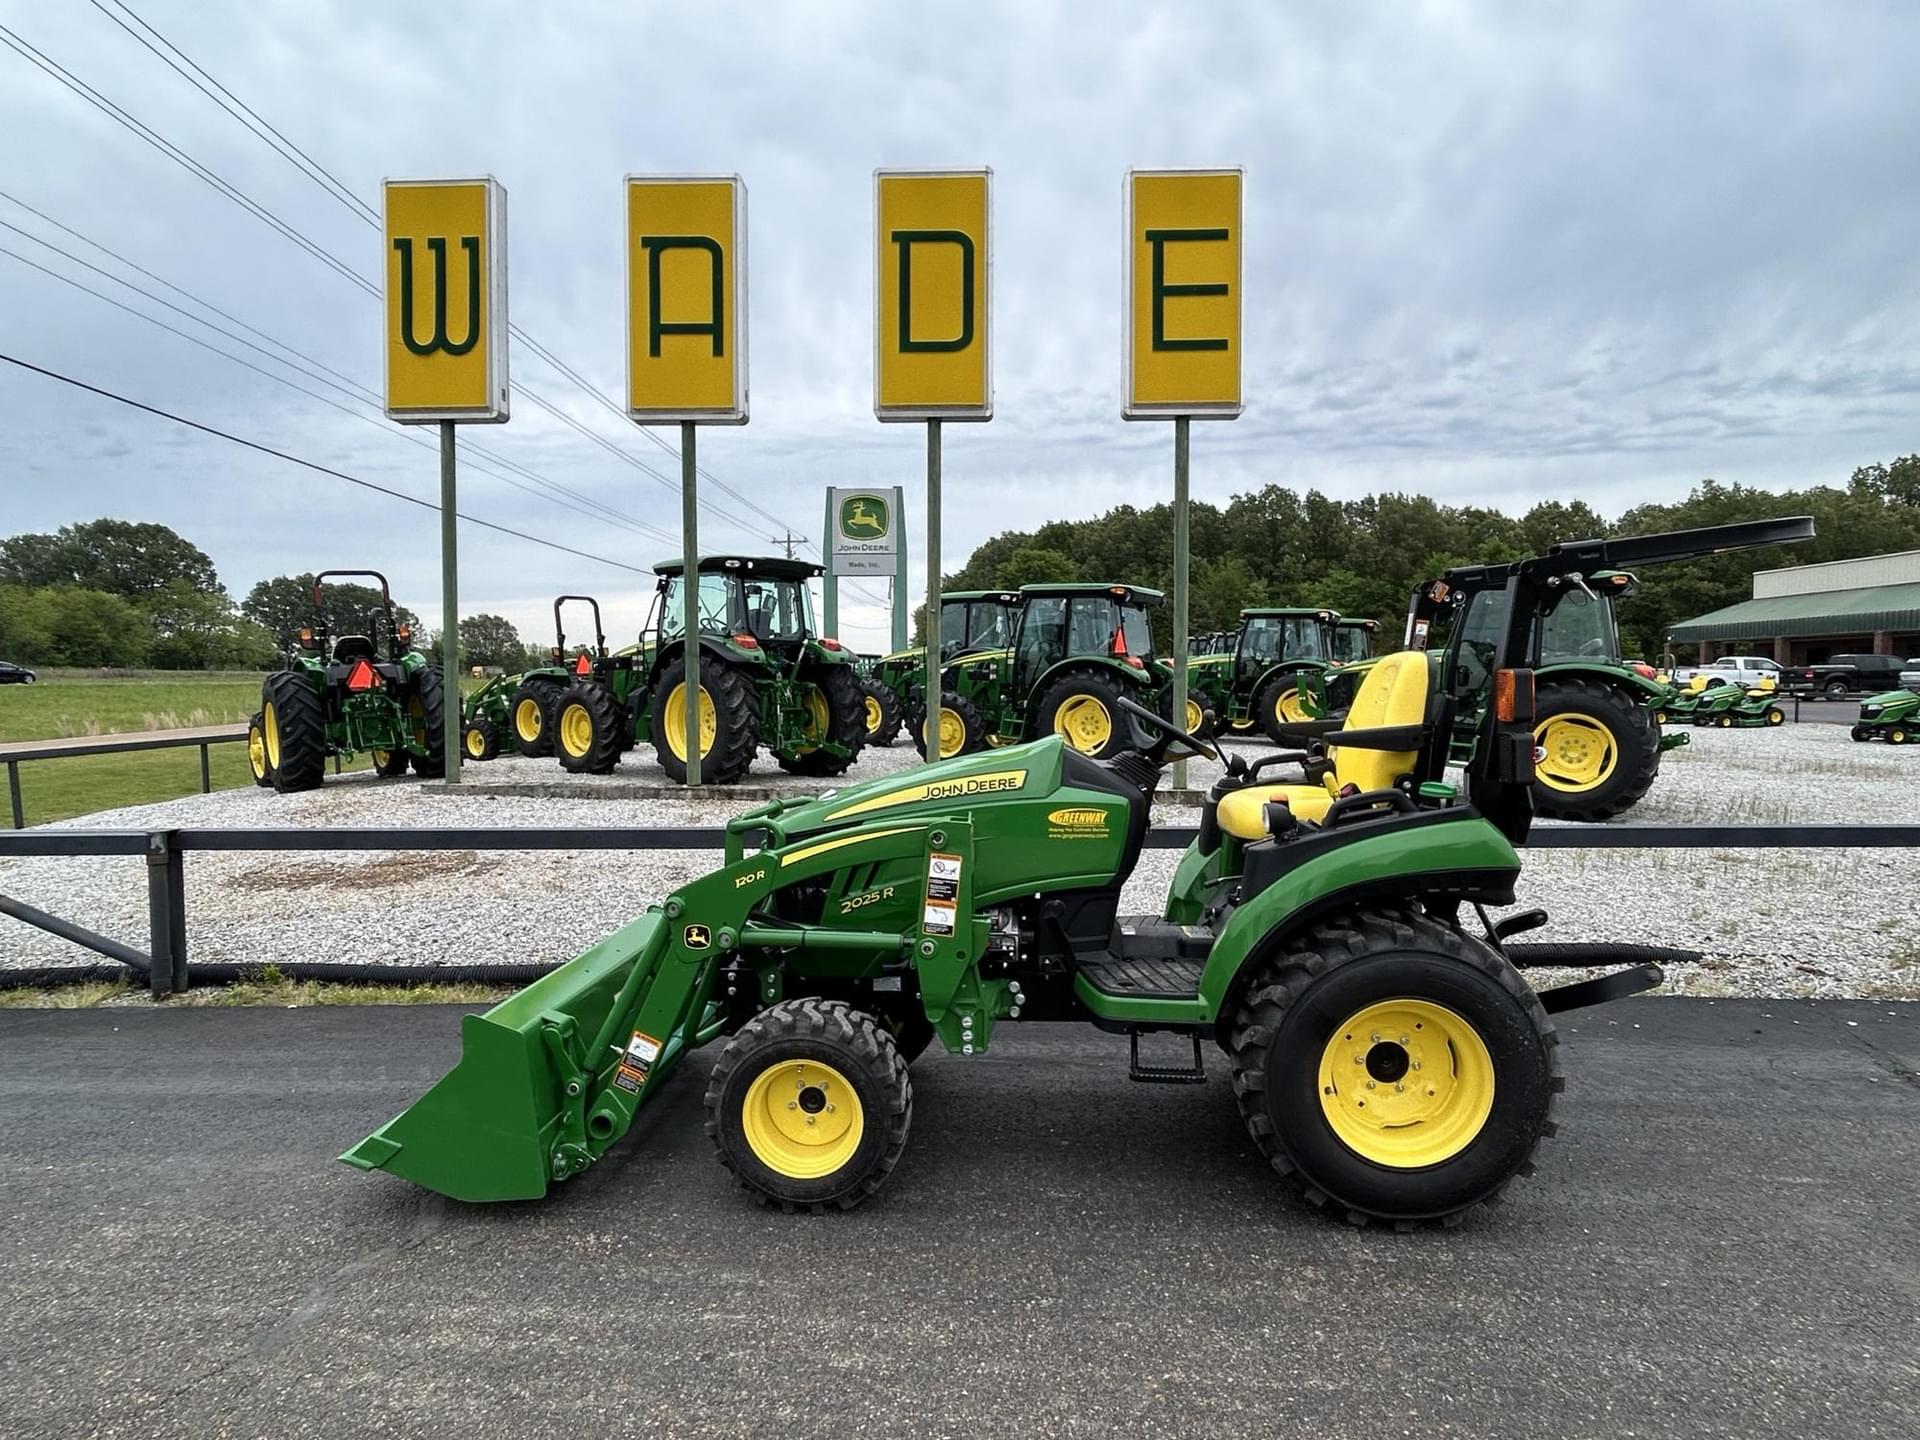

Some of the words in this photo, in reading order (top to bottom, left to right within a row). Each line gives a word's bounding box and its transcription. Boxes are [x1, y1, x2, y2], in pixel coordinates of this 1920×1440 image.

[838, 544, 860, 552] JOHN
[861, 543, 890, 552] DEERE
[922, 783, 963, 799] JOHN
[967, 777, 1017, 792] DEERE
[1056, 811, 1107, 824] GREENWAY
[735, 873, 756, 889] 120
[756, 870, 765, 880] R
[840, 892, 881, 914] 2025
[883, 887, 894, 900] R
